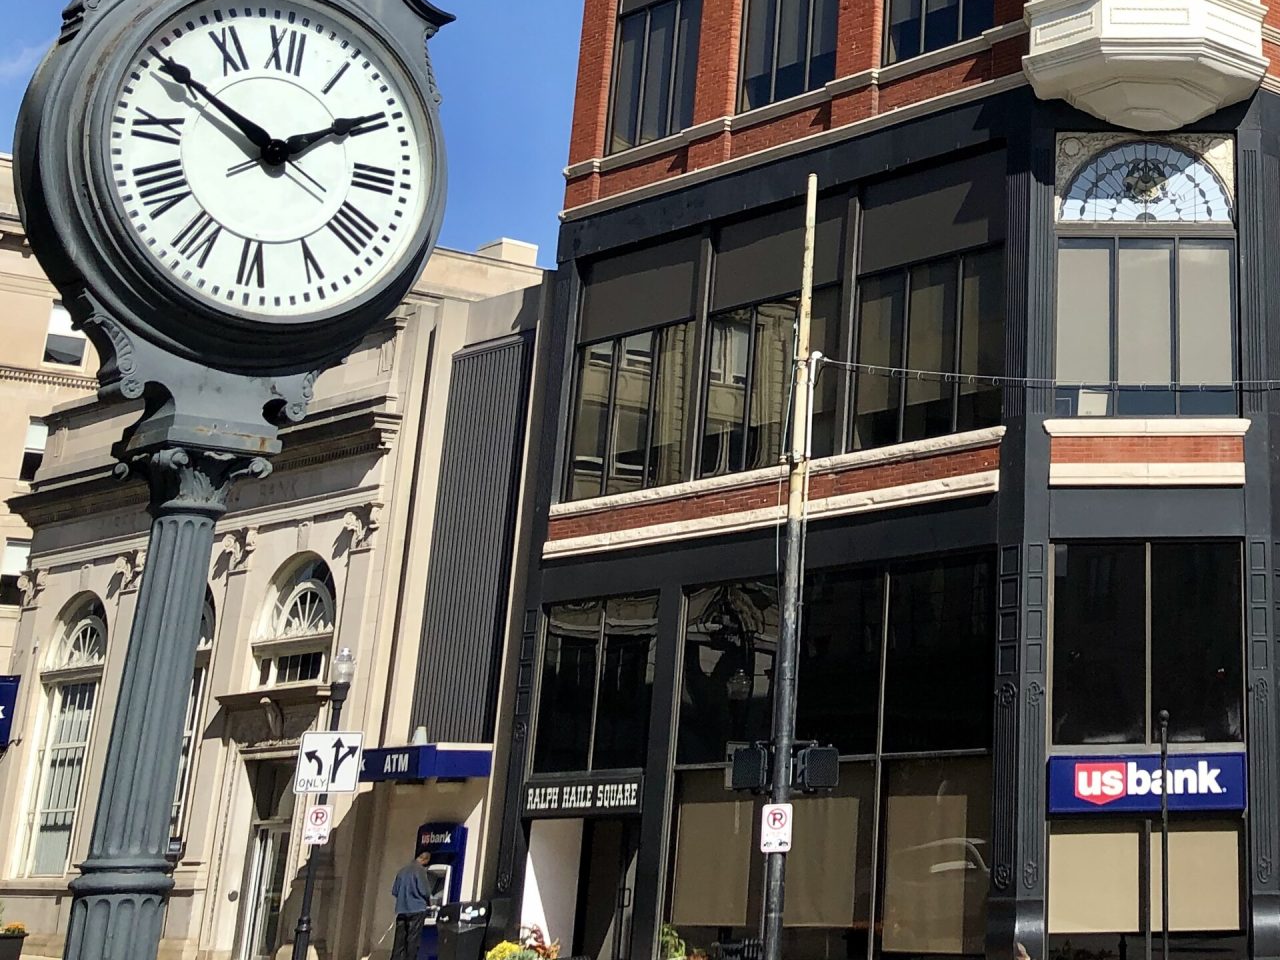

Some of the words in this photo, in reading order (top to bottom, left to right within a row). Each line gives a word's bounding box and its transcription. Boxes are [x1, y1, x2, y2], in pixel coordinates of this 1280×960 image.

[208, 25, 249, 77] XI
[263, 24, 307, 77] XII
[130, 106, 185, 145] IX
[132, 158, 192, 220] VIII
[350, 162, 396, 195] III
[170, 208, 223, 269] VII
[301, 238, 325, 284] V
[298, 778, 327, 789] ONLY
[383, 753, 409, 773] ATM
[527, 787, 559, 810] RALPH
[562, 785, 593, 809] HAILE
[596, 783, 638, 808] SQUARE
